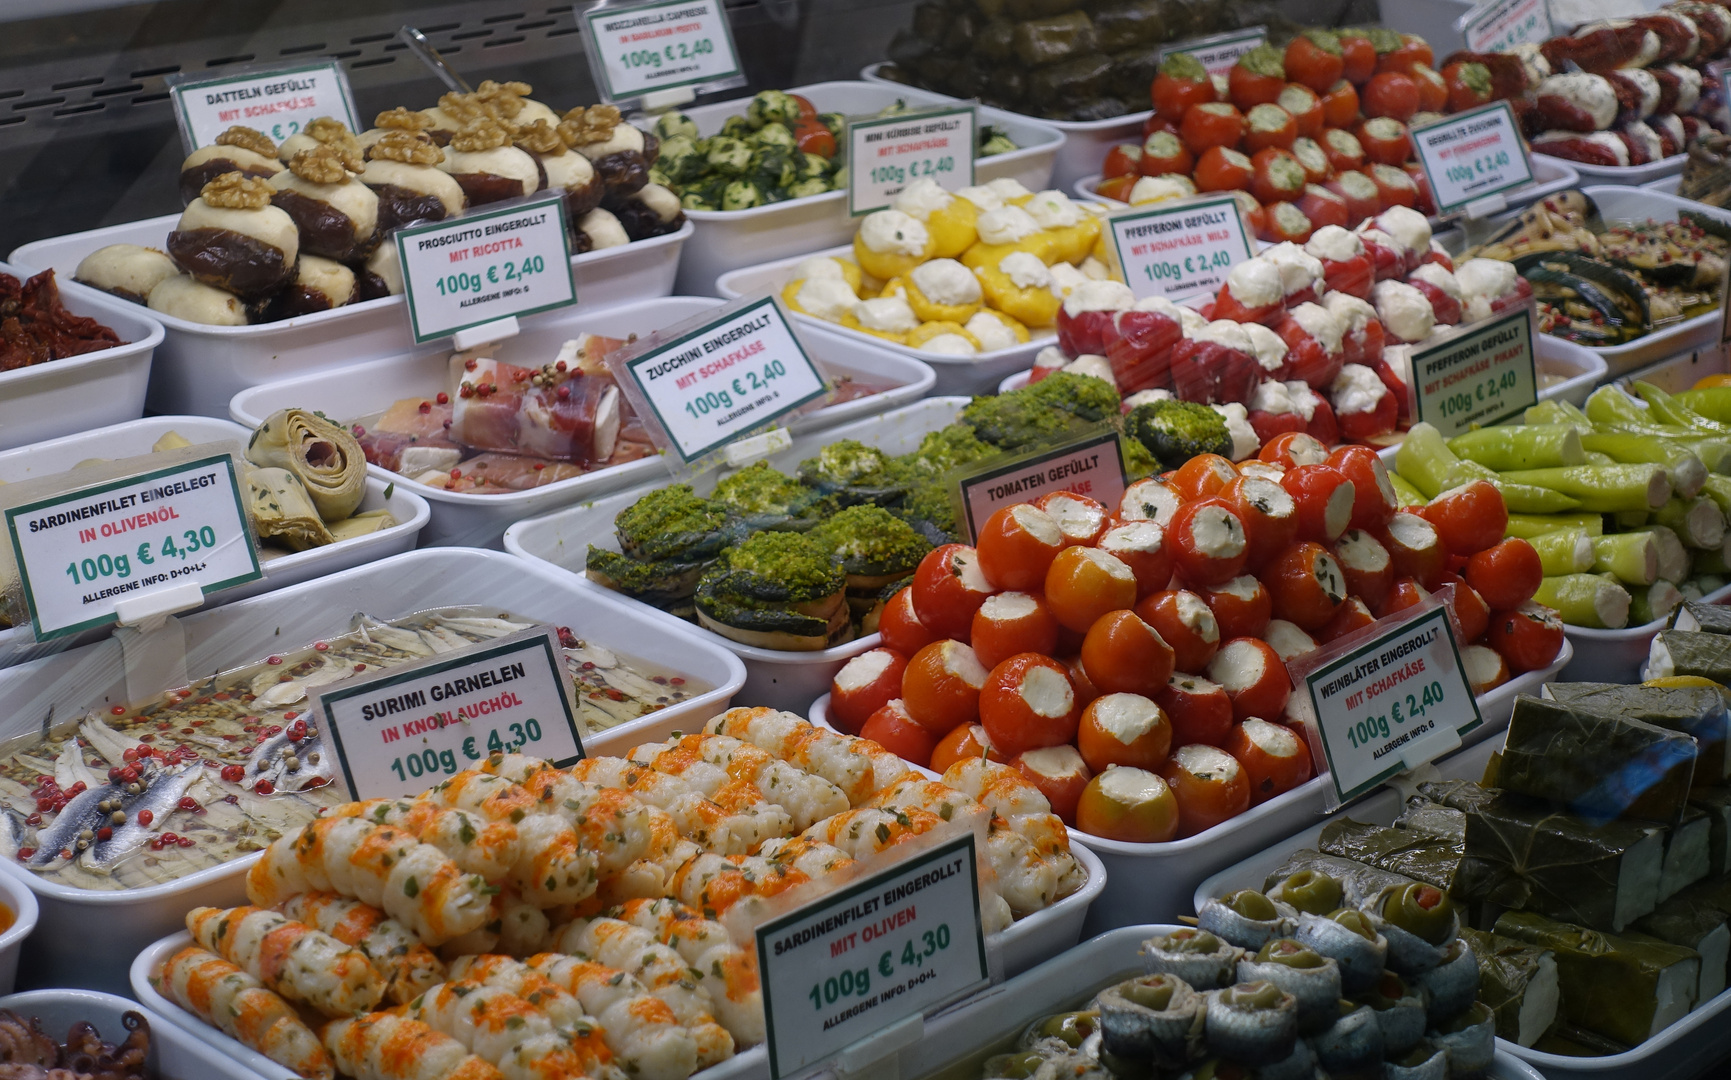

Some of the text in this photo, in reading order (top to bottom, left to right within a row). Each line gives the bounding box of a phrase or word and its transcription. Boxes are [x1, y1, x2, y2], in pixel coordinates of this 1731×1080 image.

[620, 50, 661, 69] 100g
[678, 38, 714, 60] 2,40
[206, 78, 316, 105] DATTELN GEFÜLLT
[219, 96, 316, 122] MIT SCHAFKÄSE
[870, 165, 904, 184] 100g
[922, 156, 954, 177] 2,40
[877, 146, 894, 157] MIT
[1445, 165, 1474, 182] 100g
[1485, 150, 1510, 171] 2,40
[419, 214, 547, 251] PROSCIUTTO EINGEROLLT
[1125, 212, 1226, 239] PFEFFERONI GEFÜLLT
[1131, 230, 1230, 256] MIT SCHAFKÄSE MILD
[449, 237, 523, 263] MIT RICOTTA
[1145, 262, 1181, 281] 100g
[1197, 251, 1230, 272] 2,40
[436, 255, 544, 296] 100g € 2,40
[460, 292, 500, 308] ALLERGENE
[646, 314, 772, 380] ZUCCHINI EINGEROLLT
[675, 340, 766, 390] MIT SCHAFKÄSE
[1425, 344, 1524, 396] MIT SCHAFKÄSE PIKANT
[1426, 326, 1519, 375] PFEFFERONI GEFÜLLT
[685, 360, 786, 419] 100g € 2,40
[1440, 393, 1472, 418] 100g
[1488, 370, 1516, 397] 2,40
[717, 404, 755, 427] ALLERGENE
[988, 472, 1045, 501] TOMATEN
[1049, 455, 1098, 482] GEFÜLLT
[29, 473, 217, 533] SARDINENFILET EINGELEGT
[79, 506, 179, 544] IN OLIVENÖL
[66, 525, 216, 586] 100g € 4,30
[82, 562, 207, 605] ALLERGENE INFO: D+O+L+
[1321, 627, 1439, 699] WEINBLÄTER EINGEROLLT
[1345, 658, 1426, 711] MIT SCHAFKÄSE
[362, 662, 525, 721] SURIMI GARNELEN
[1348, 681, 1444, 749] 100g € 2,40
[381, 692, 523, 743] IN KNOBLAUCHÖL
[391, 718, 542, 782] 100g € 4,30
[1372, 733, 1410, 761] ALLERGENE
[1410, 725, 1429, 741] INFO:
[774, 859, 963, 956] SARDINENFILET EINGEROLLT
[830, 905, 917, 958] MIT OLIVEN
[809, 923, 950, 1011] 100g € 4,30
[823, 969, 937, 1032] ALLERGENE INFO: D+O+L
